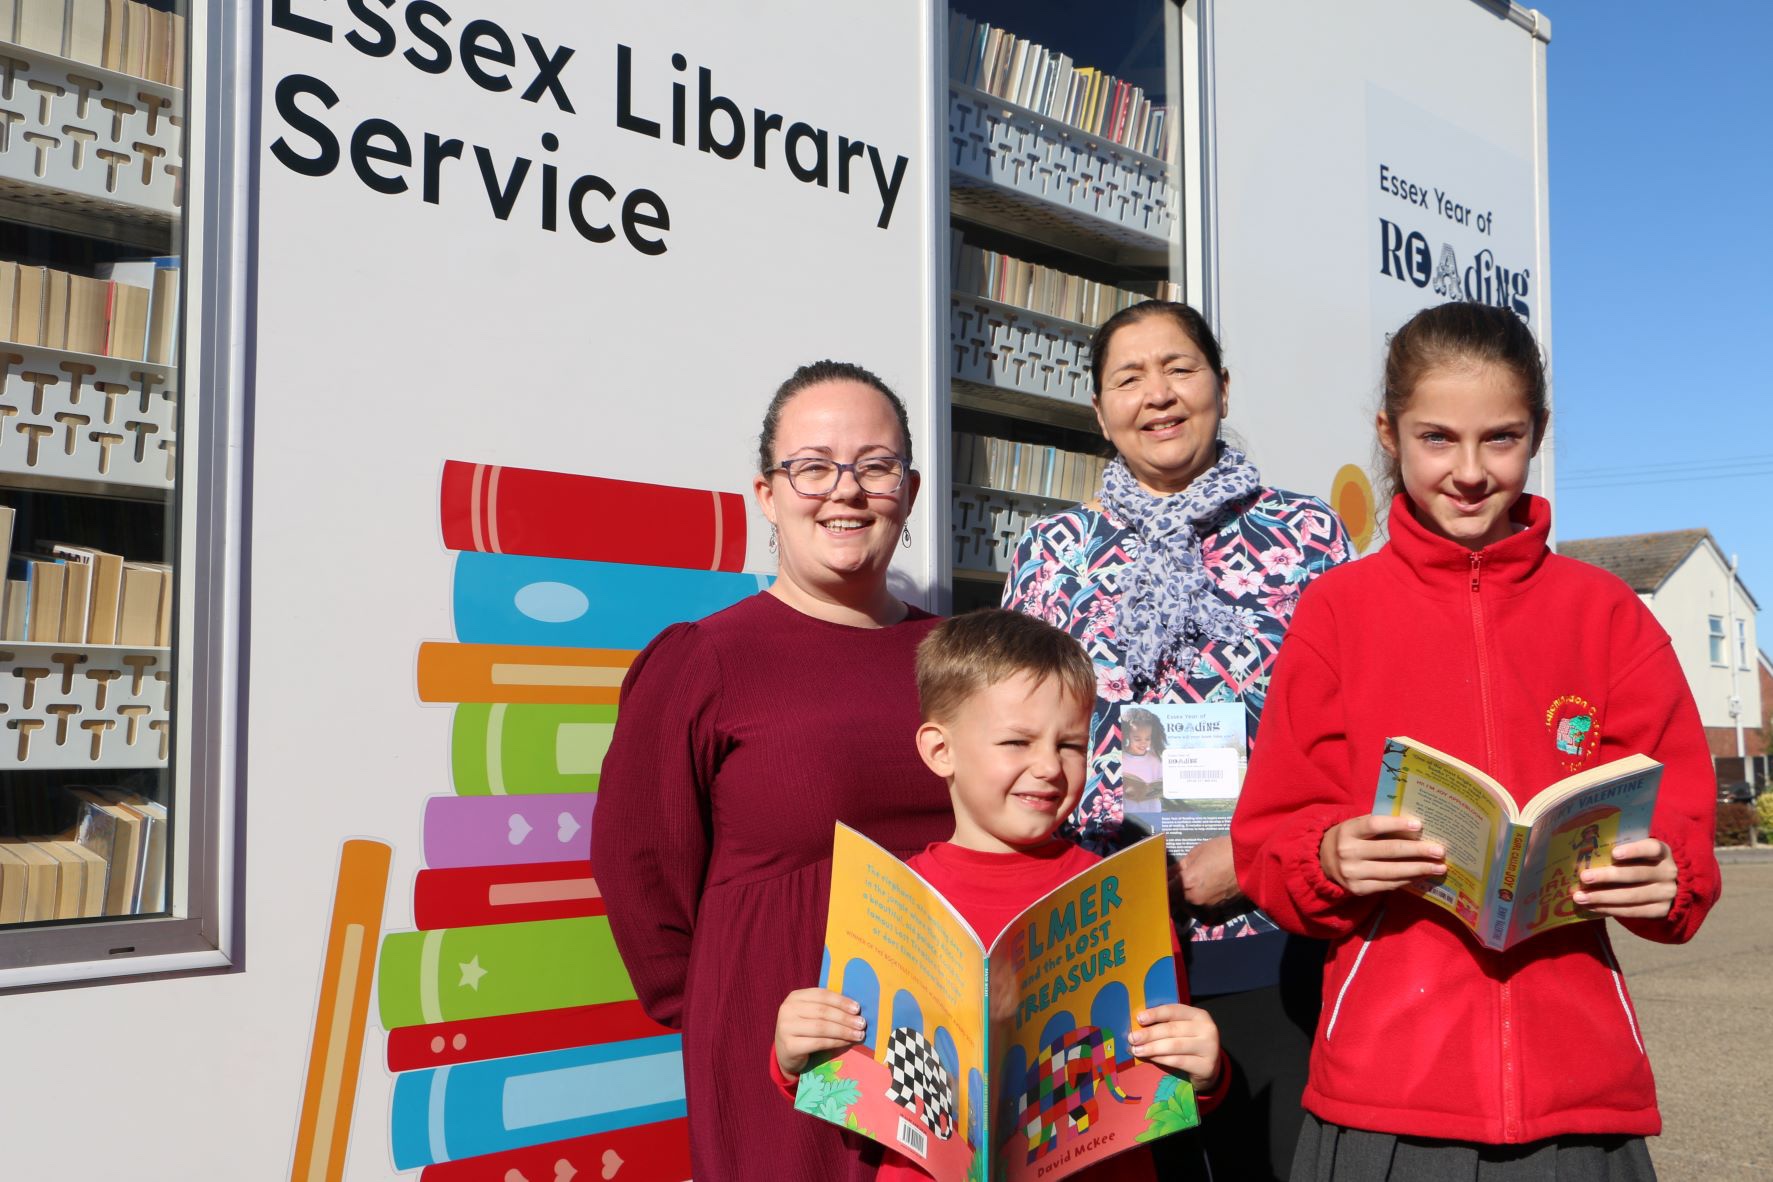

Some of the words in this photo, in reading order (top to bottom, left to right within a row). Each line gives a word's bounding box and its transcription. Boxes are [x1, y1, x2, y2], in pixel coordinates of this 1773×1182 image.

[271, 0, 576, 115] ssex
[616, 42, 909, 230] Library
[269, 73, 670, 256] Service
[1380, 164, 1429, 209] Essex
[1434, 188, 1471, 226] Year
[1477, 211, 1492, 236] of
[1579, 778, 1645, 808] VALENTINE
[1552, 867, 1563, 877] A
[1010, 876, 1123, 975] ELMER
[1022, 965, 1041, 990] and
[1044, 955, 1062, 973] the
[1066, 920, 1111, 961] LOST
[1016, 939, 1126, 1030] TREASURE
[1037, 1150, 1071, 1178] David
[1074, 1132, 1116, 1157] McKee
